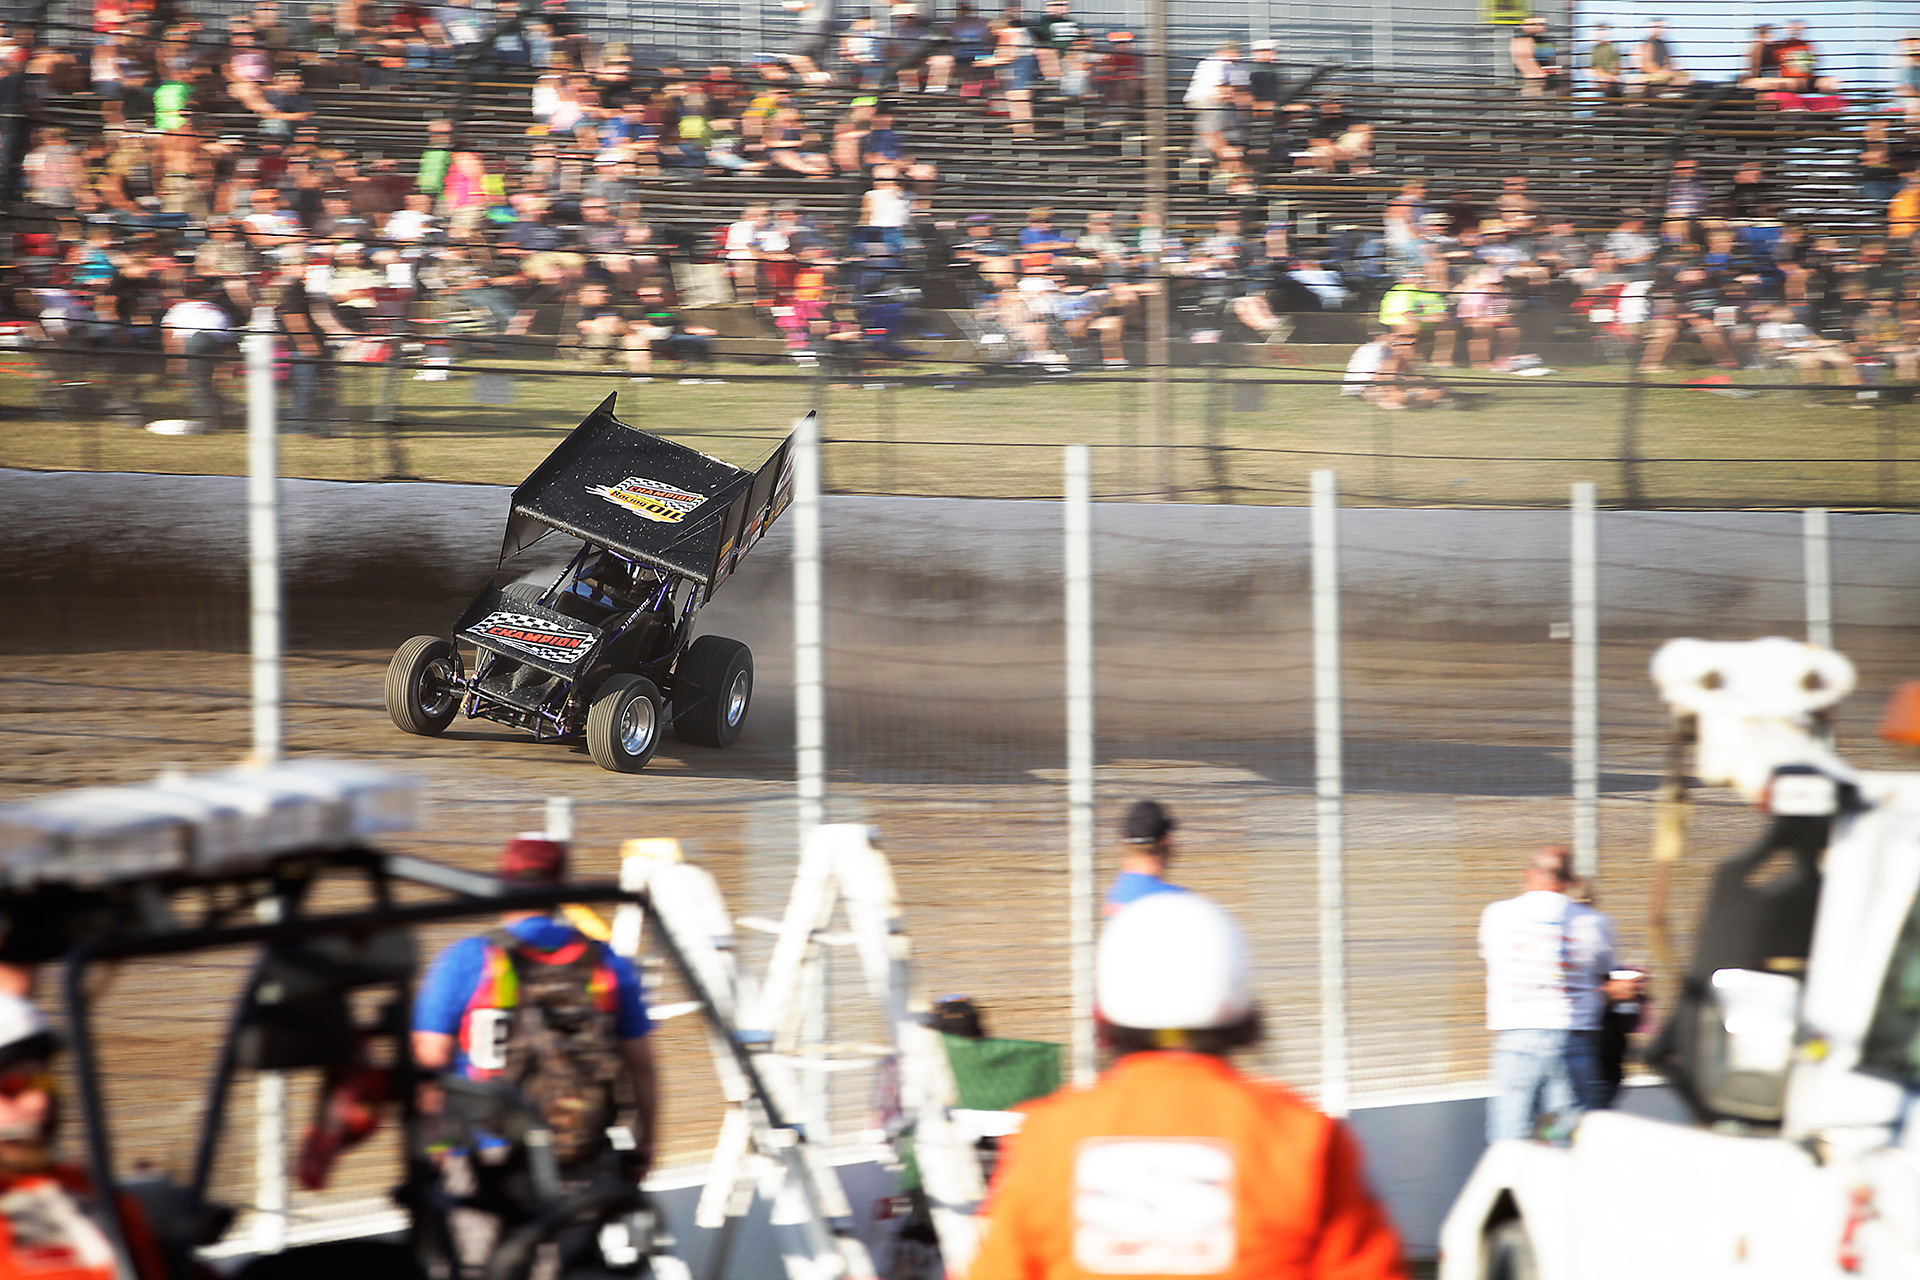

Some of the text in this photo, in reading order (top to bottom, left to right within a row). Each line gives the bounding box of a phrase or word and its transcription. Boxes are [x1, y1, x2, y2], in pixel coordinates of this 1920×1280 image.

[628, 485, 697, 503] CHAMPION
[645, 503, 684, 521] OIL
[487, 626, 584, 649] CHAMPION
